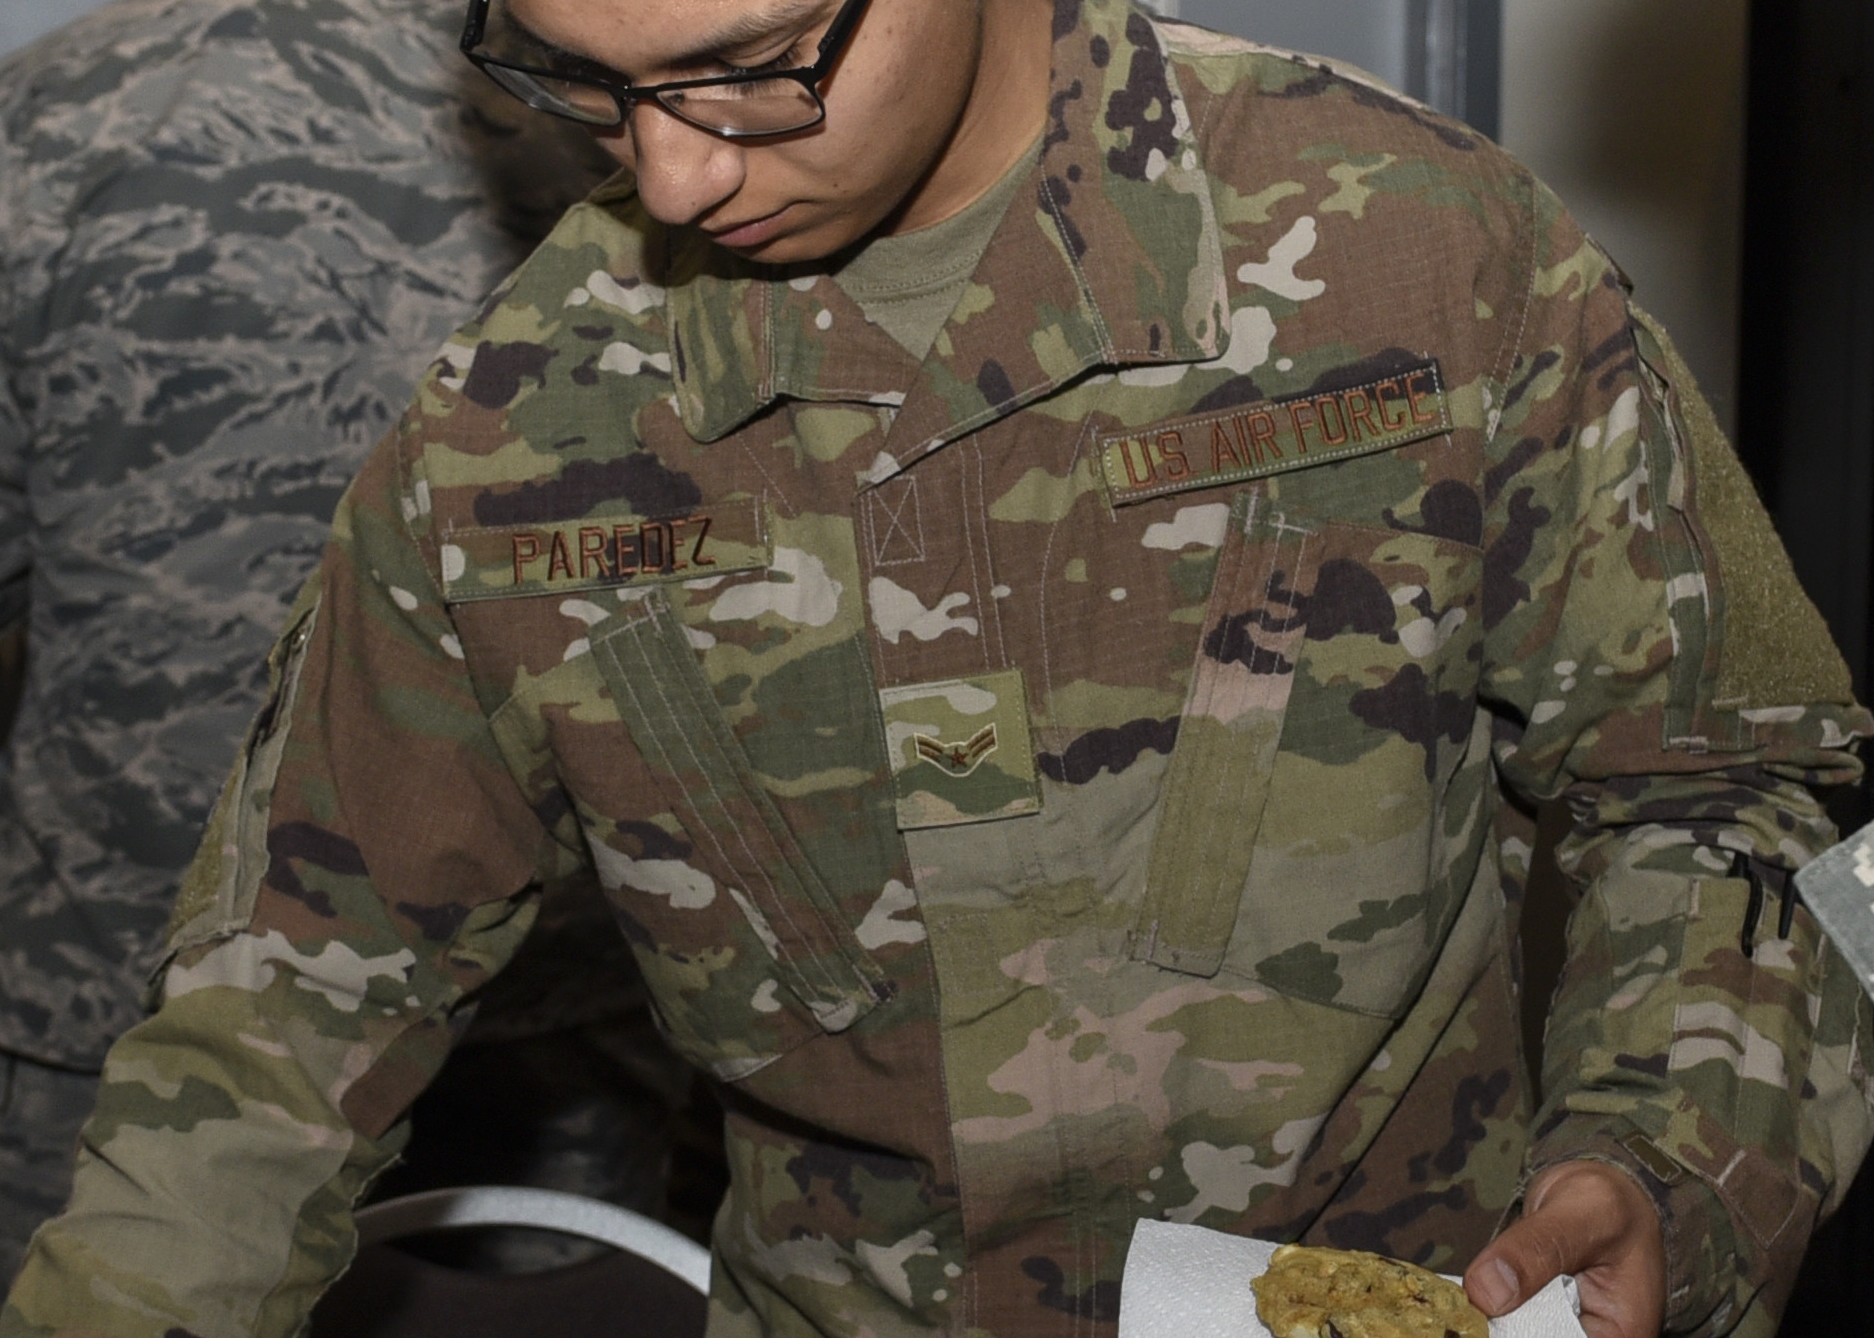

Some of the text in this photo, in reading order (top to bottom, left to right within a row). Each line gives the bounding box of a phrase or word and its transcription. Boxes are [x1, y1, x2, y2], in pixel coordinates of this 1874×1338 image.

[1210, 412, 1283, 472] AIR
[1289, 372, 1436, 453] FORCE
[512, 514, 716, 585] PAREDEZ
